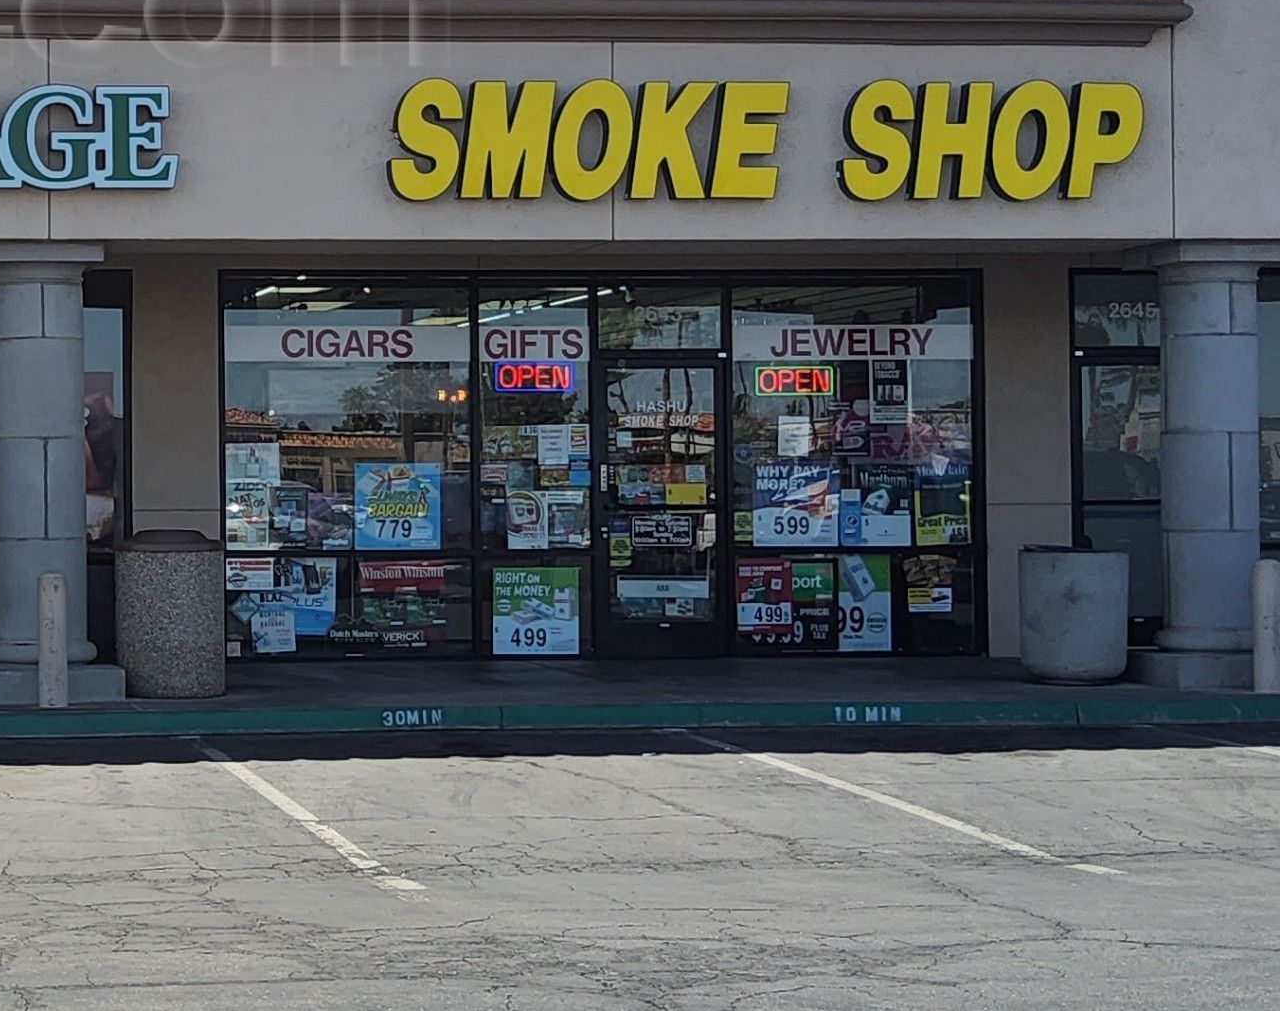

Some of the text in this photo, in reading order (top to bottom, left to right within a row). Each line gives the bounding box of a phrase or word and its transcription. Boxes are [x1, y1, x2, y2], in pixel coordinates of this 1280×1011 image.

[386, 76, 1146, 203] SMOKE SHOP
[1108, 301, 1157, 318] 2645
[280, 328, 415, 359] CIGARS
[483, 328, 585, 360] GIFTS
[770, 327, 933, 358] JEWELRY
[498, 364, 571, 389] OPEN
[758, 368, 830, 393] OPEN
[636, 400, 687, 413] HASHU
[624, 414, 699, 427] SMOKE SHOP
[755, 465, 789, 478] WHY
[755, 478, 807, 491] MORE?
[367, 502, 428, 519] BARGAIN
[375, 519, 413, 539] 779
[773, 515, 811, 536] 599
[917, 516, 969, 528] Great Price
[360, 566, 445, 580] Winston Winston
[494, 571, 541, 584] RIGHT ON
[495, 585, 552, 598] THE MONEY
[754, 606, 783, 623] 499
[799, 607, 831, 617] PRICE
[510, 626, 548, 648] 499
[381, 708, 444, 728] 30MIN
[834, 706, 902, 723] 10 MIN
